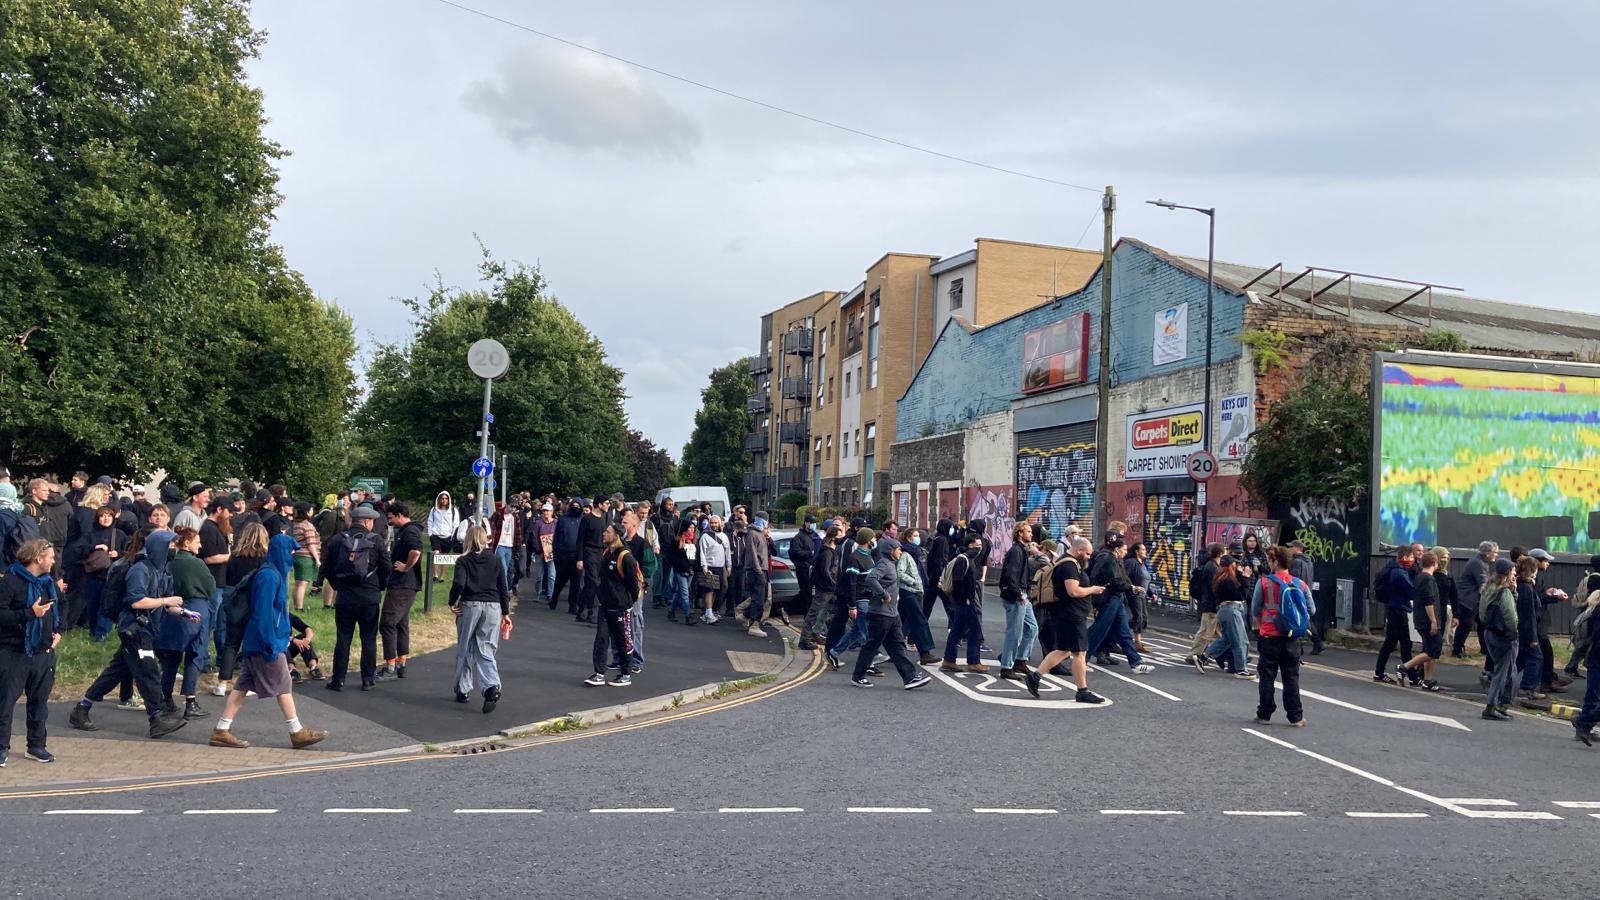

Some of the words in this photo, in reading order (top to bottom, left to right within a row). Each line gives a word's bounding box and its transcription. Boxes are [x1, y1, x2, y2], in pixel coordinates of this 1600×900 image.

[474, 350, 503, 367] 20
[1221, 398, 1236, 410] KEYS
[1236, 396, 1248, 408] CUT
[1221, 412, 1232, 421] HERE
[1136, 425, 1168, 443] Carpets
[1171, 419, 1199, 437] Direct
[1128, 458, 1157, 473] CARPET
[1192, 459, 1213, 473] 20
